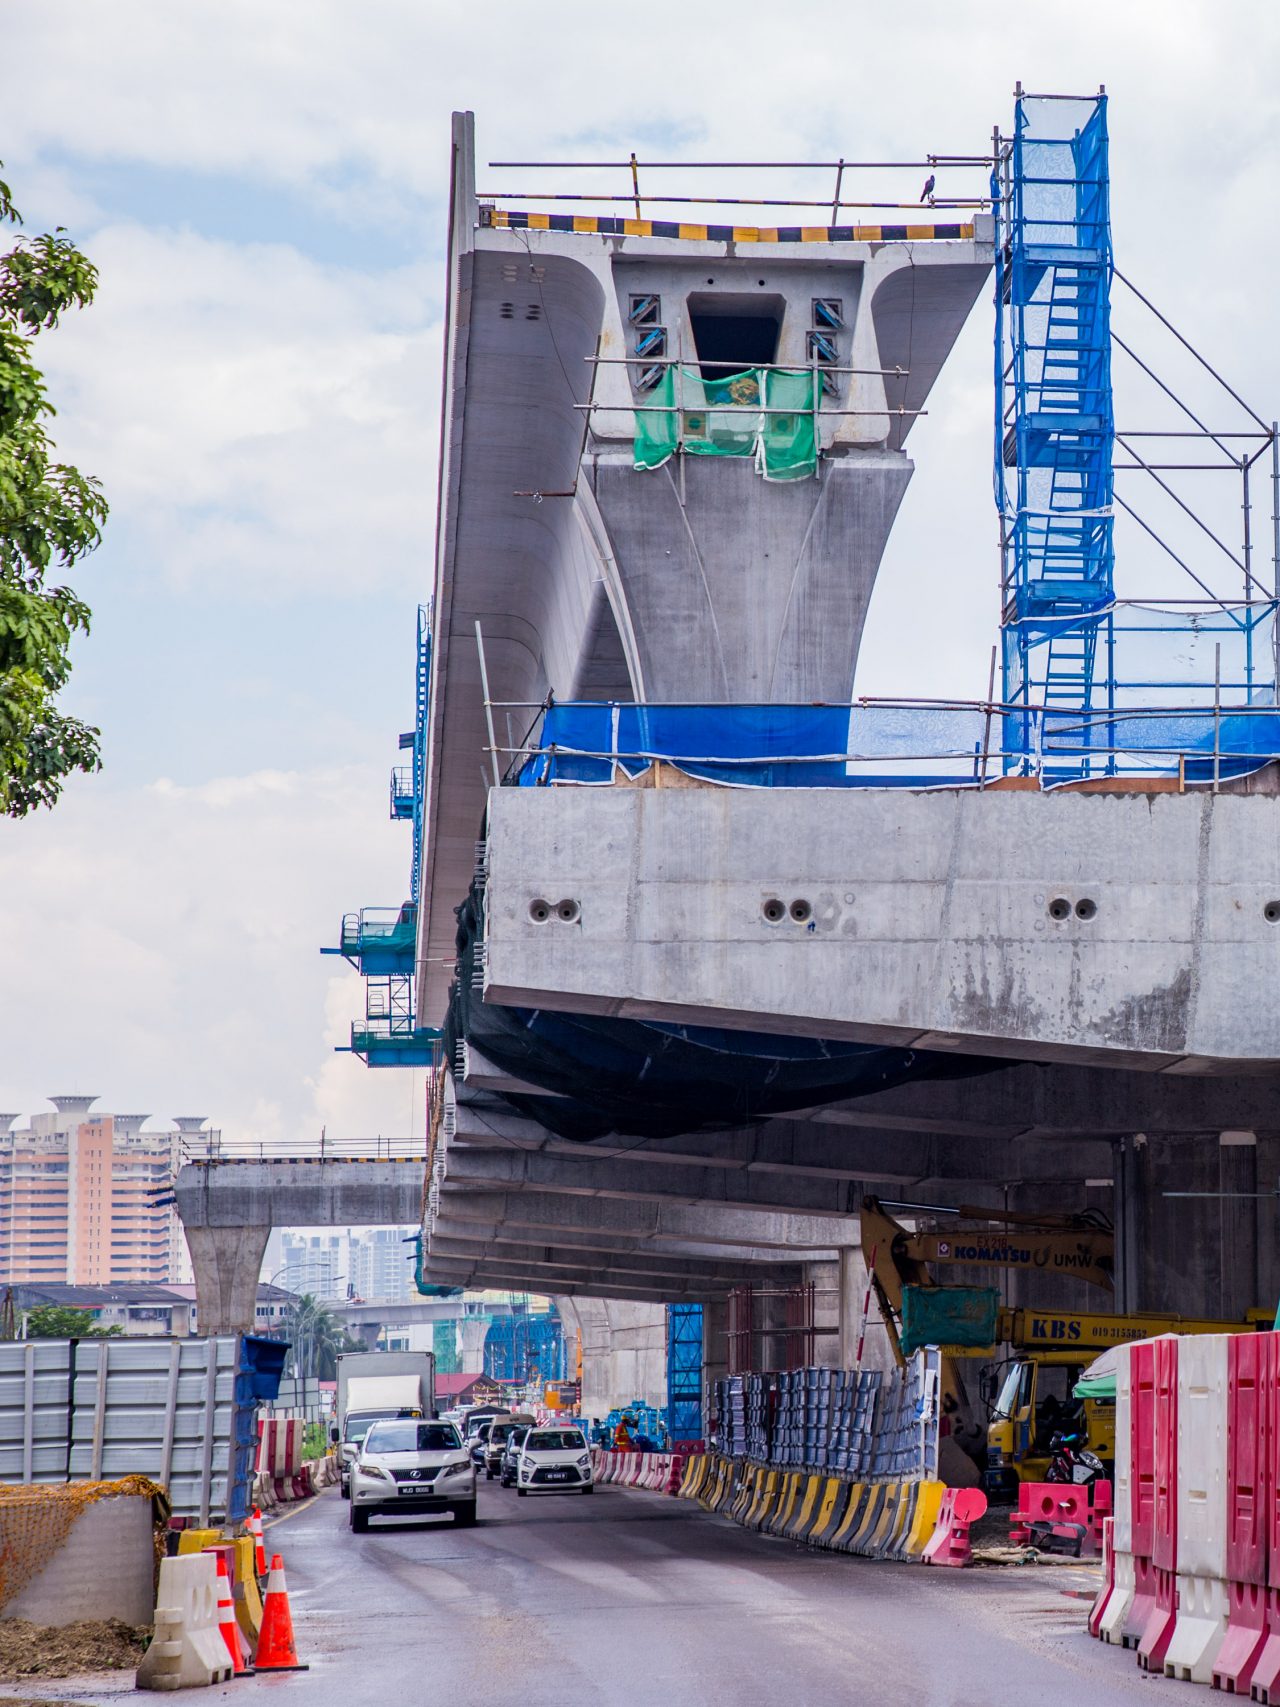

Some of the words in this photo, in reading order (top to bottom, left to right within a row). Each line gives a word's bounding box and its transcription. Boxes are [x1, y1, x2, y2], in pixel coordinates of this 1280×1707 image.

[977, 1236, 990, 1249] EX
[991, 1238, 1008, 1249] 218
[954, 1245, 1031, 1263] KOMATSU
[1054, 1254, 1093, 1267] UMW
[1031, 1319, 1081, 1339] KBS
[1092, 1326, 1109, 1337] 019
